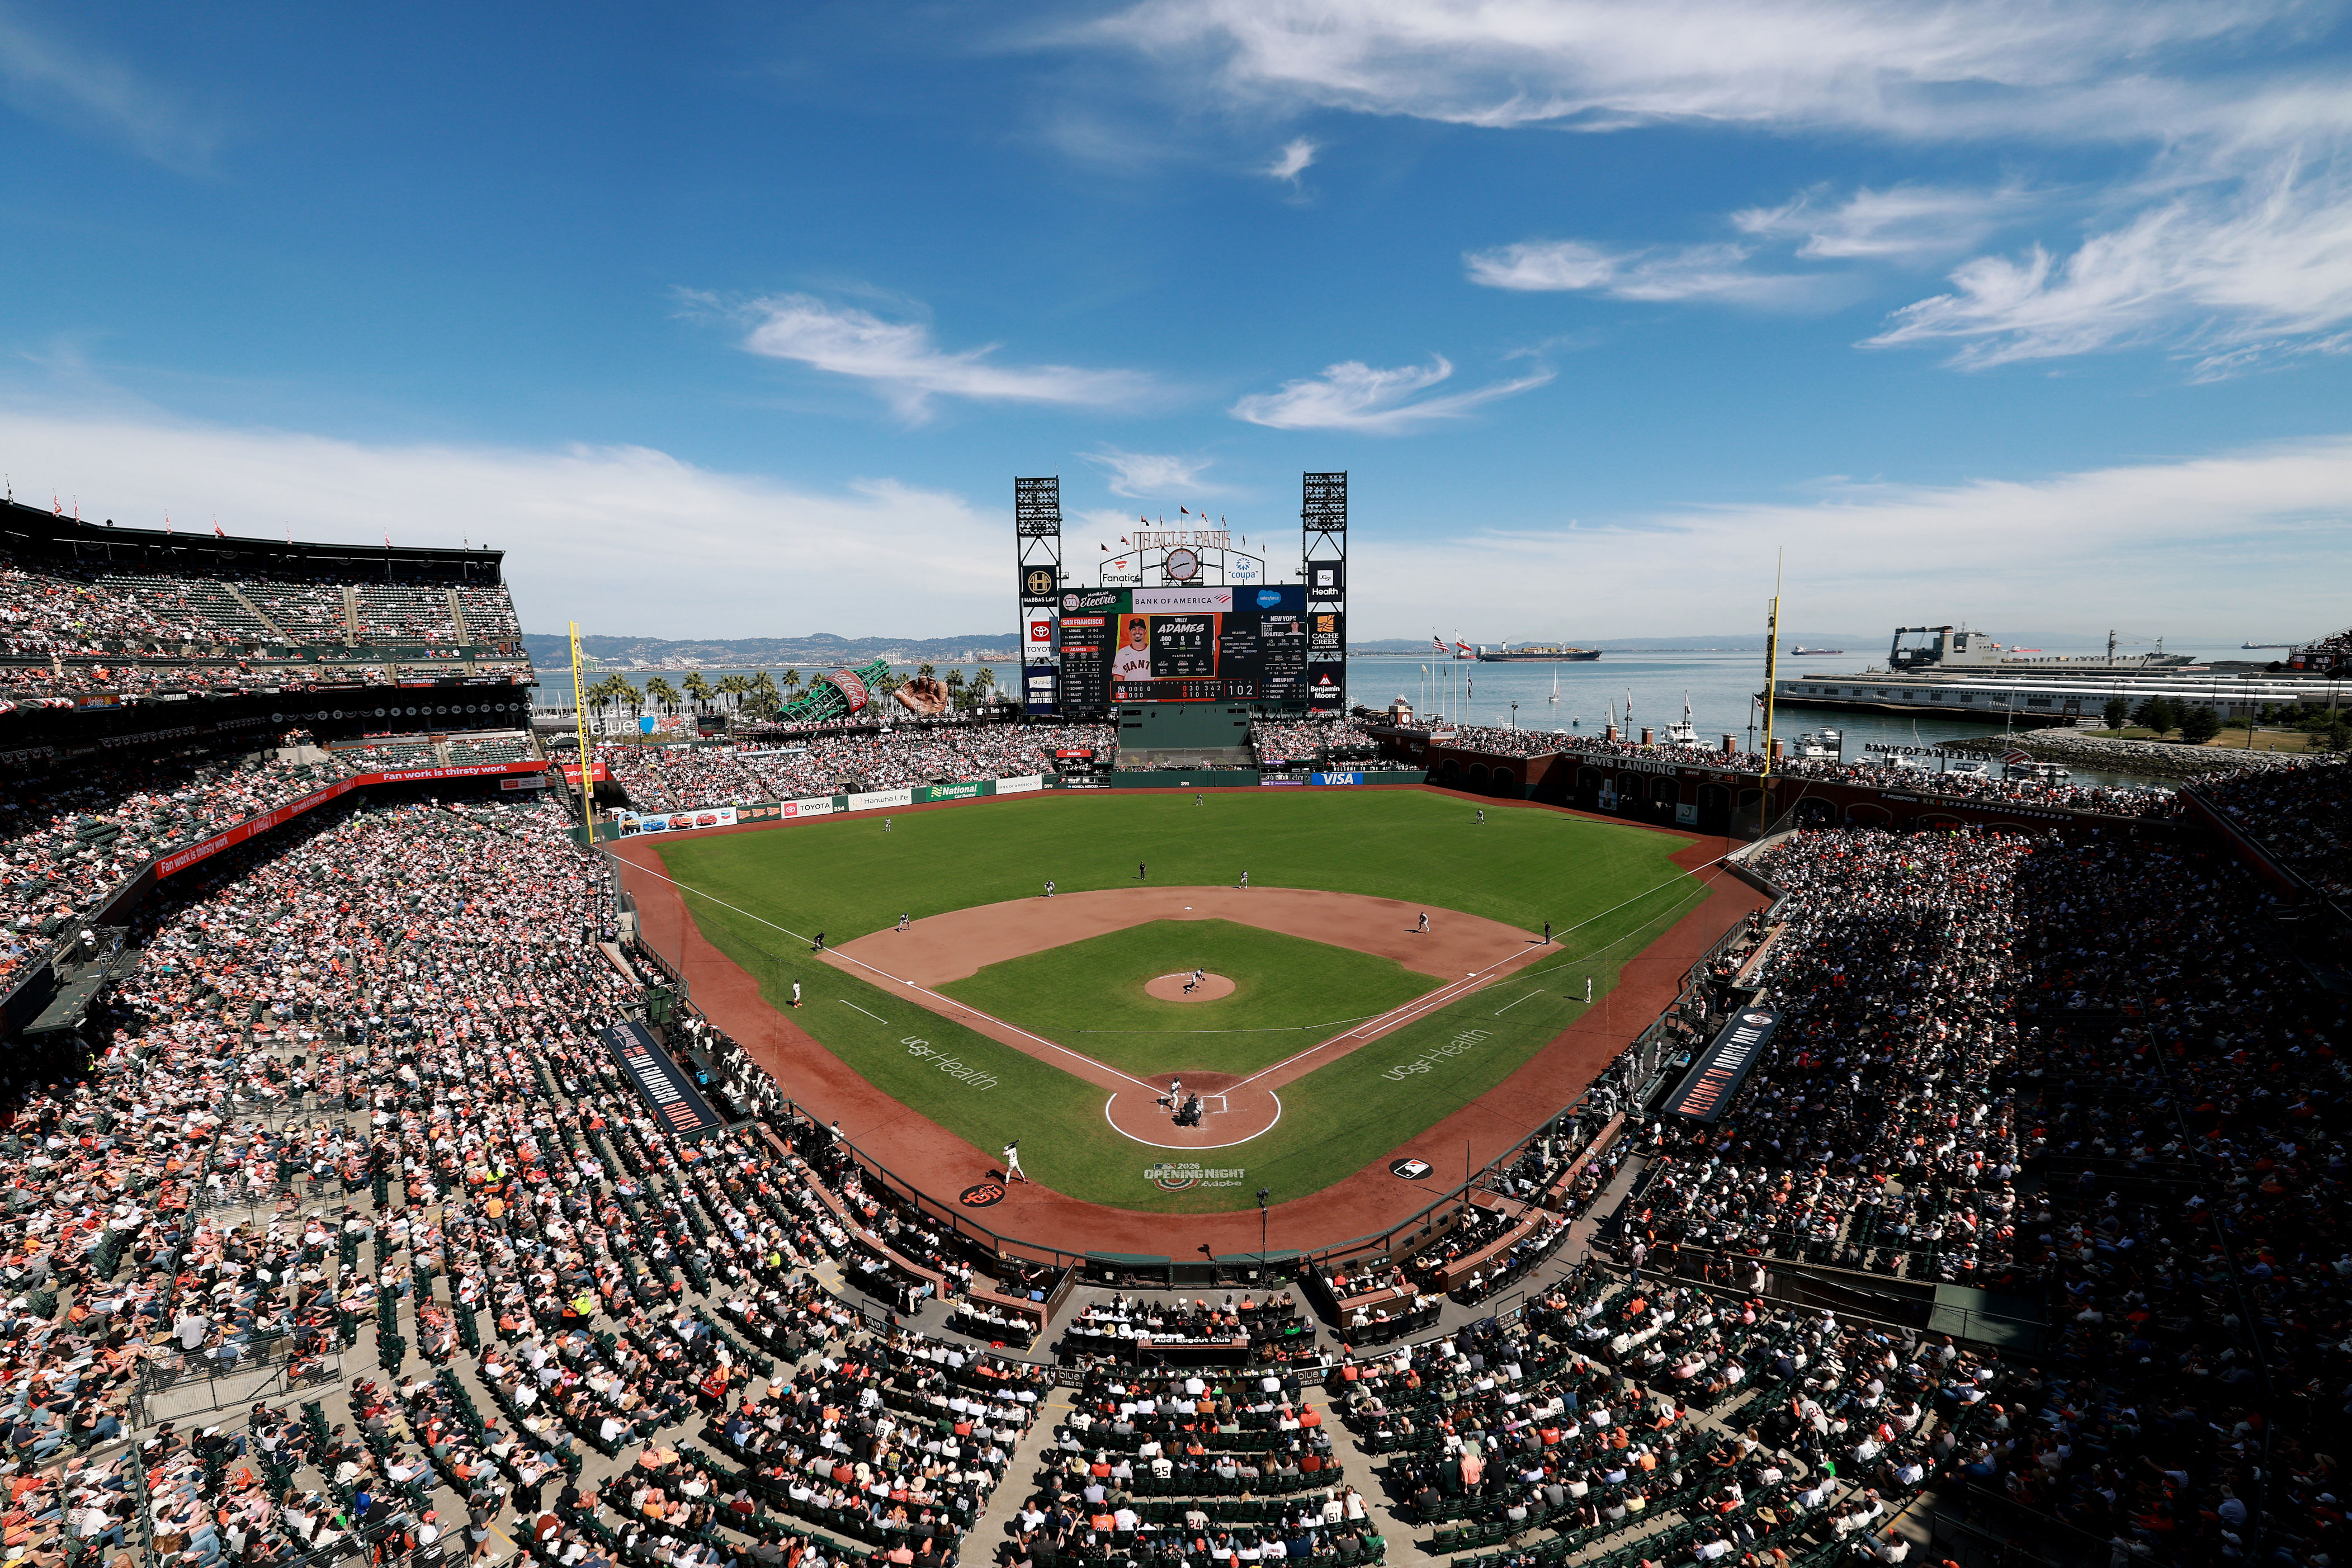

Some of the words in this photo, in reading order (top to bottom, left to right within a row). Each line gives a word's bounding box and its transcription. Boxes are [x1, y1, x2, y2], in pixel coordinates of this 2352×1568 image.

[1132, 532, 1188, 552] ORACLE
[1194, 531, 1231, 551] PARK
[1231, 570, 1255, 579] coupa
[1080, 594, 1116, 607] Electric
[1158, 624, 1205, 633] ADAMES
[1229, 686, 1232, 695] 1
[1238, 685, 1243, 695] 0
[1246, 685, 1252, 695] 2
[87, 697, 104, 707] Surfside
[579, 696, 583, 705] 4
[590, 718, 635, 735] blue
[1865, 744, 1901, 754] BANK
[1905, 747, 1921, 755] OF
[1924, 748, 1993, 762] AMERICA
[445, 767, 479, 777] thirsty
[1618, 760, 1676, 776] LANDING
[1321, 774, 1354, 785] VISA
[943, 784, 977, 795] National
[299, 801, 307, 810] work
[161, 861, 174, 873] Fan
[174, 852, 190, 867] work
[190, 849, 196, 860] is
[196, 842, 215, 857] thirsty
[215, 835, 228, 849] work
[1730, 1027, 1762, 1045] PARK
[1381, 1060, 1433, 1081] UCSF
[1419, 1029, 1493, 1062] Health
[1712, 1043, 1751, 1069] ORACLE
[628, 1054, 655, 1069] SAN
[900, 1036, 937, 1056] UCSF
[925, 1052, 998, 1090] Health
[1704, 1069, 1734, 1080] TO
[637, 1066, 682, 1104] FRANCISCO
[1678, 1078, 1726, 1116] WELCOME
[662, 1102, 702, 1131] GIANTS
[1144, 1169, 1203, 1179] OPENING
[1205, 1169, 1245, 1178] NIGHT
[866, 1315, 880, 1328] blue
[1499, 1314, 1514, 1325] blue
[1059, 1371, 1080, 1381] blue
[1298, 1371, 1319, 1380] blue
[1808, 1406, 1821, 1418] 24
[877, 1427, 885, 1436] 18
[1885, 1425, 1895, 1441] 13
[1155, 1466, 1168, 1477] 25
[956, 1498, 970, 1510] 99
[1329, 1513, 1338, 1522] 51
[1189, 1519, 1201, 1529] 24
